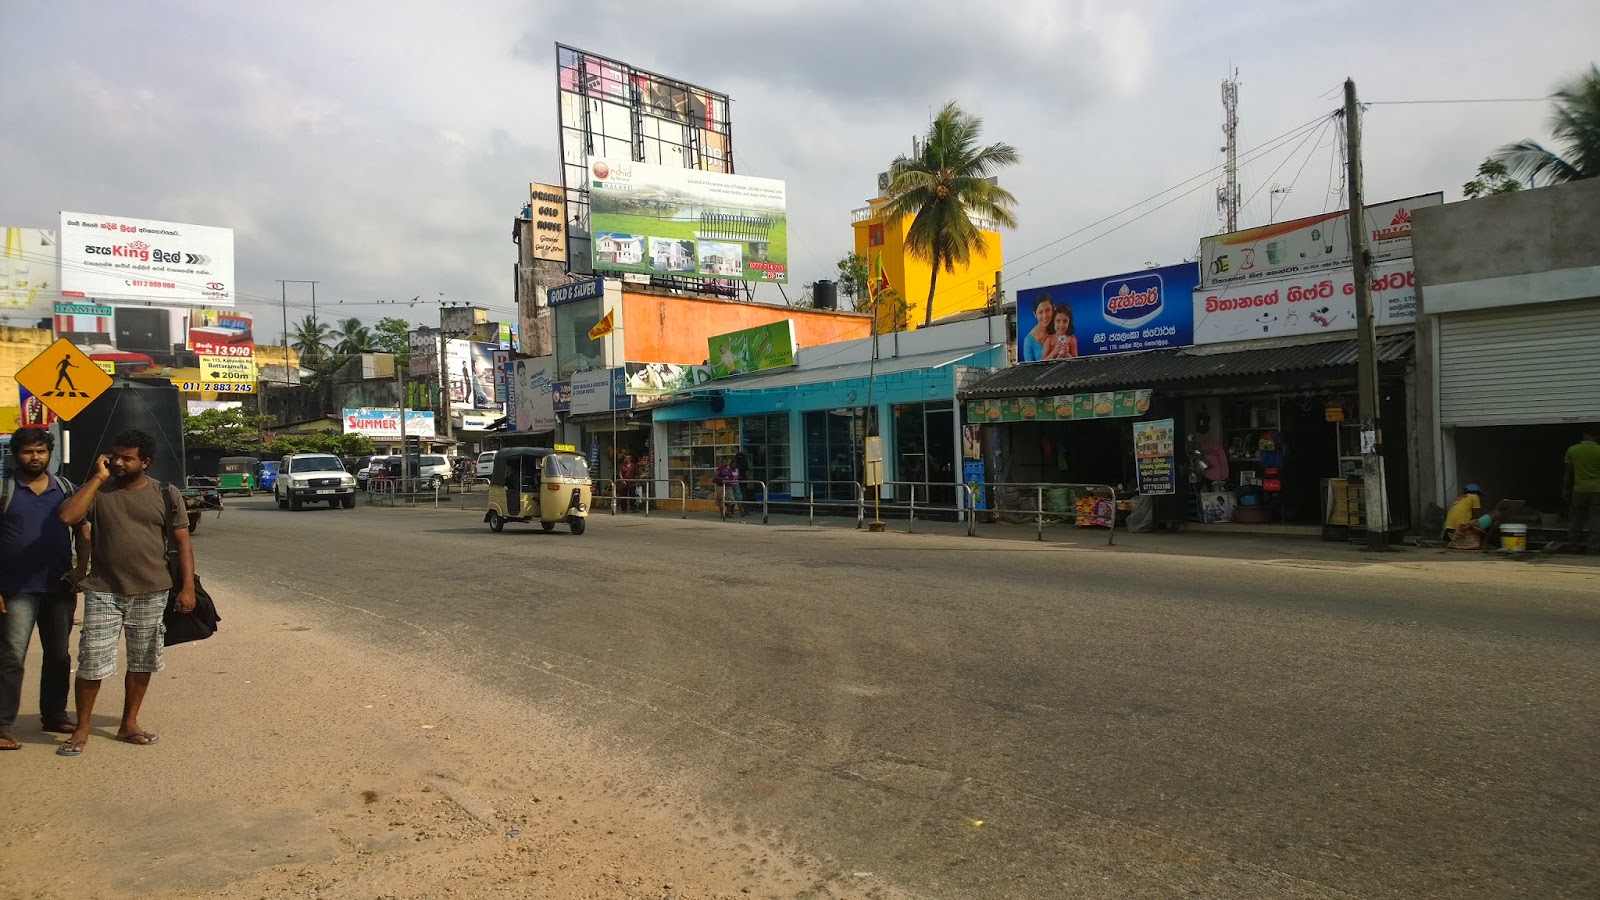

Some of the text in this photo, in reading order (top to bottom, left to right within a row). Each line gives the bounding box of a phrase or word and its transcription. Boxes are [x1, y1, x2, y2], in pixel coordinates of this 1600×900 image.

[538, 206, 559, 217] GOLD
[537, 220, 561, 232] HOUSE
[153, 249, 181, 263] මුදල්
[551, 289, 567, 303] GOLD
[568, 288, 574, 298] &
[1107, 286, 1158, 314] ඇන්කර්
[1205, 289, 1279, 313] විතානගේ
[1287, 280, 1335, 302] ගිෆ්ට්
[57, 304, 110, 315] DAMRO
[1108, 331, 1140, 342] ජයලංකා
[214, 345, 251, 356] 13,900
[183, 382, 252, 392] 011 2 883 245
[506, 368, 516, 426] Nestomalt
[348, 415, 397, 430] SUMMER
